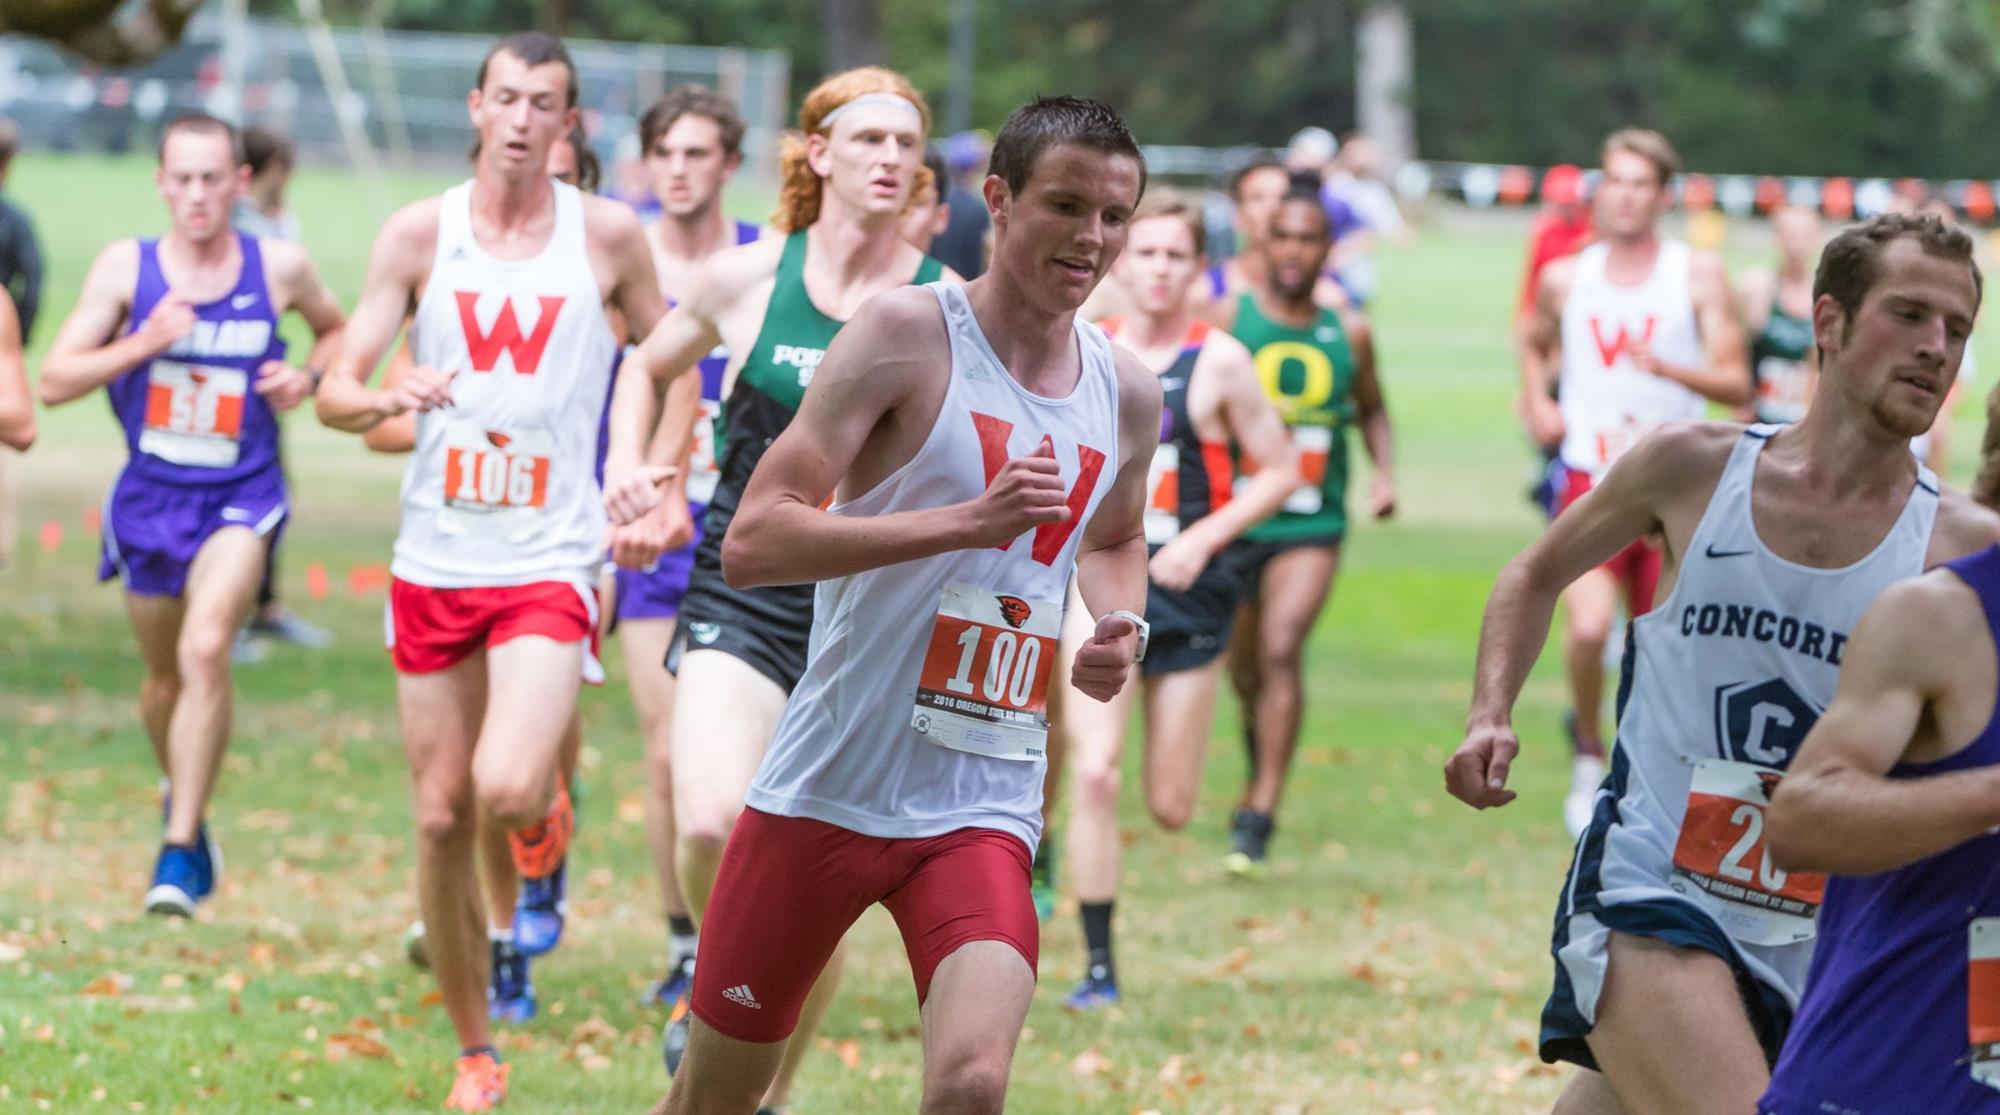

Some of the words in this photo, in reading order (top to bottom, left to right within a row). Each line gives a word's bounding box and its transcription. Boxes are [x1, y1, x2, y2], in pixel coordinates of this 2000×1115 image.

[453, 289, 567, 375] W
[456, 450, 536, 506] 106
[969, 410, 1106, 567] W
[945, 625, 1041, 707] 100
[933, 694, 954, 708] 2016
[955, 699, 989, 716] OREGON
[1743, 701, 1795, 764] C
[722, 990, 762, 1010] adidas
